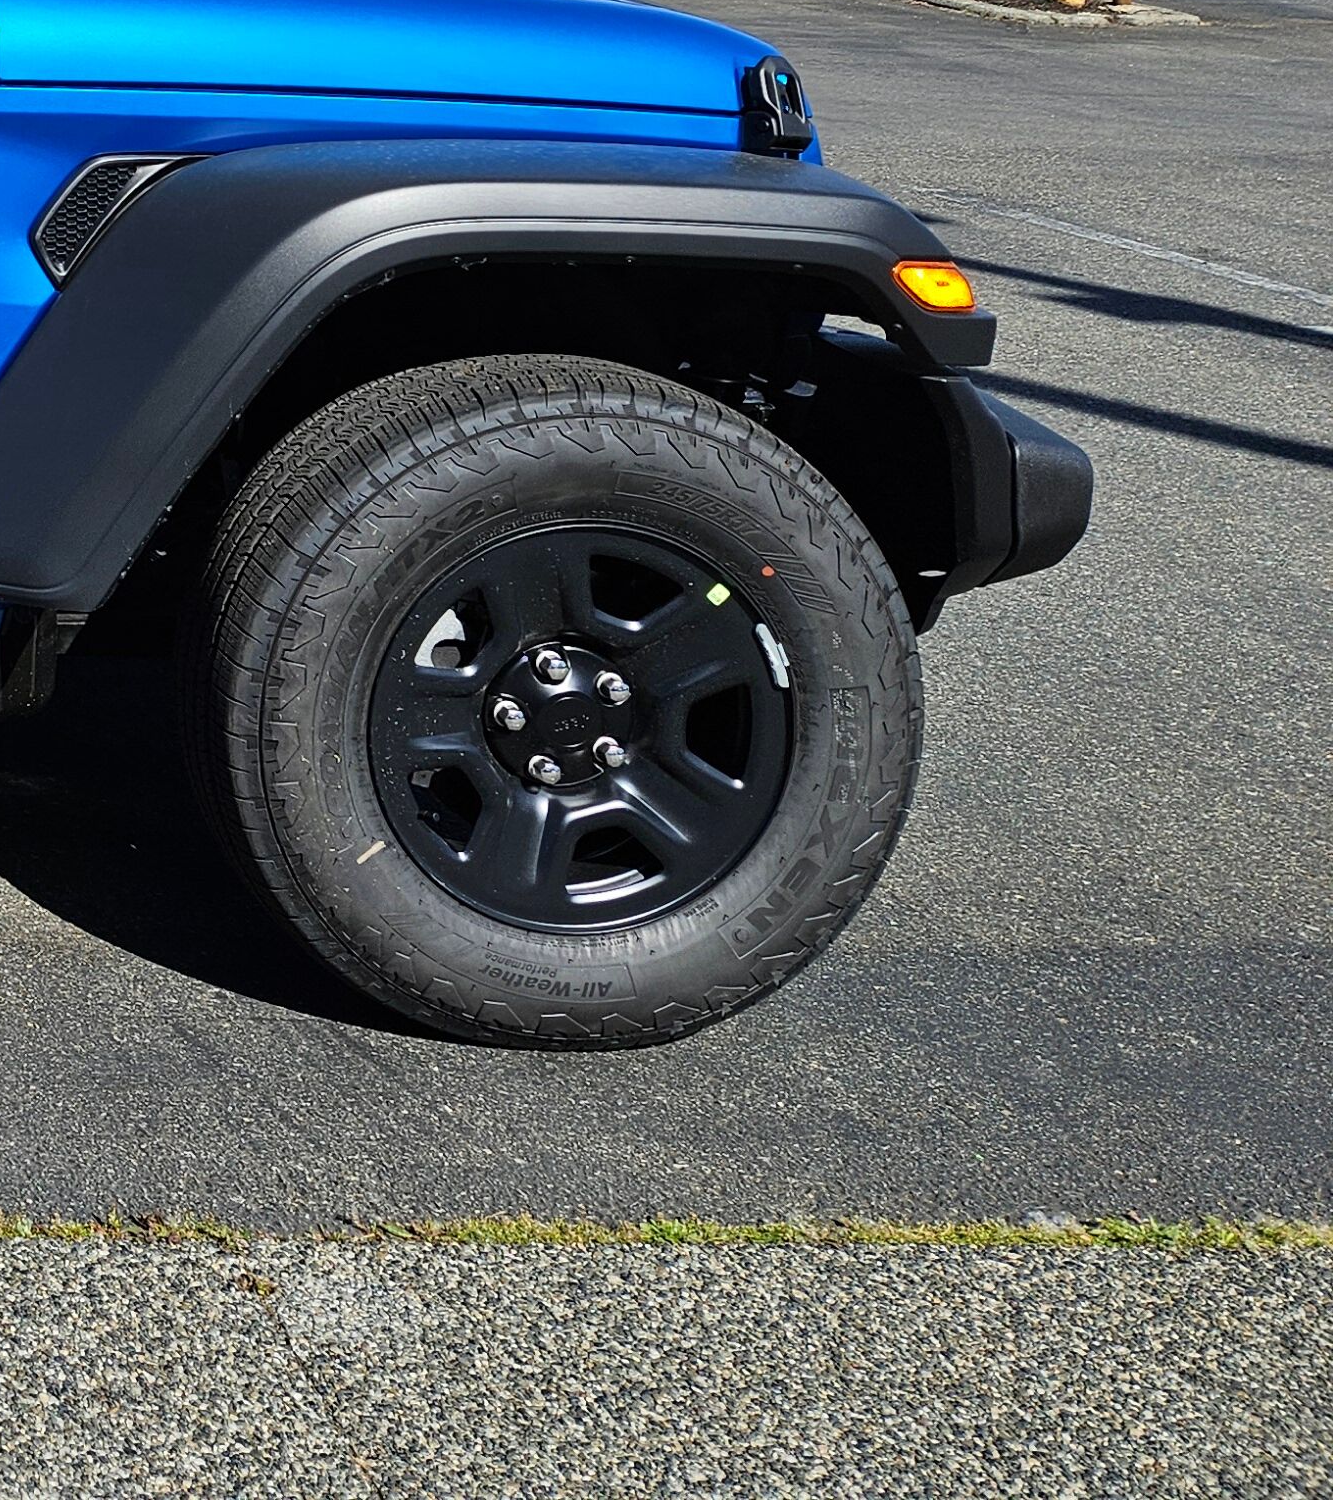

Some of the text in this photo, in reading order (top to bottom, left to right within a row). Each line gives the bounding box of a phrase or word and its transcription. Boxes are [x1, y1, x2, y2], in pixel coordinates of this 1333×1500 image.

[371, 497, 489, 601] HTX2
[477, 962, 613, 998] All-Weather
[483, 951, 558, 979] Performance
